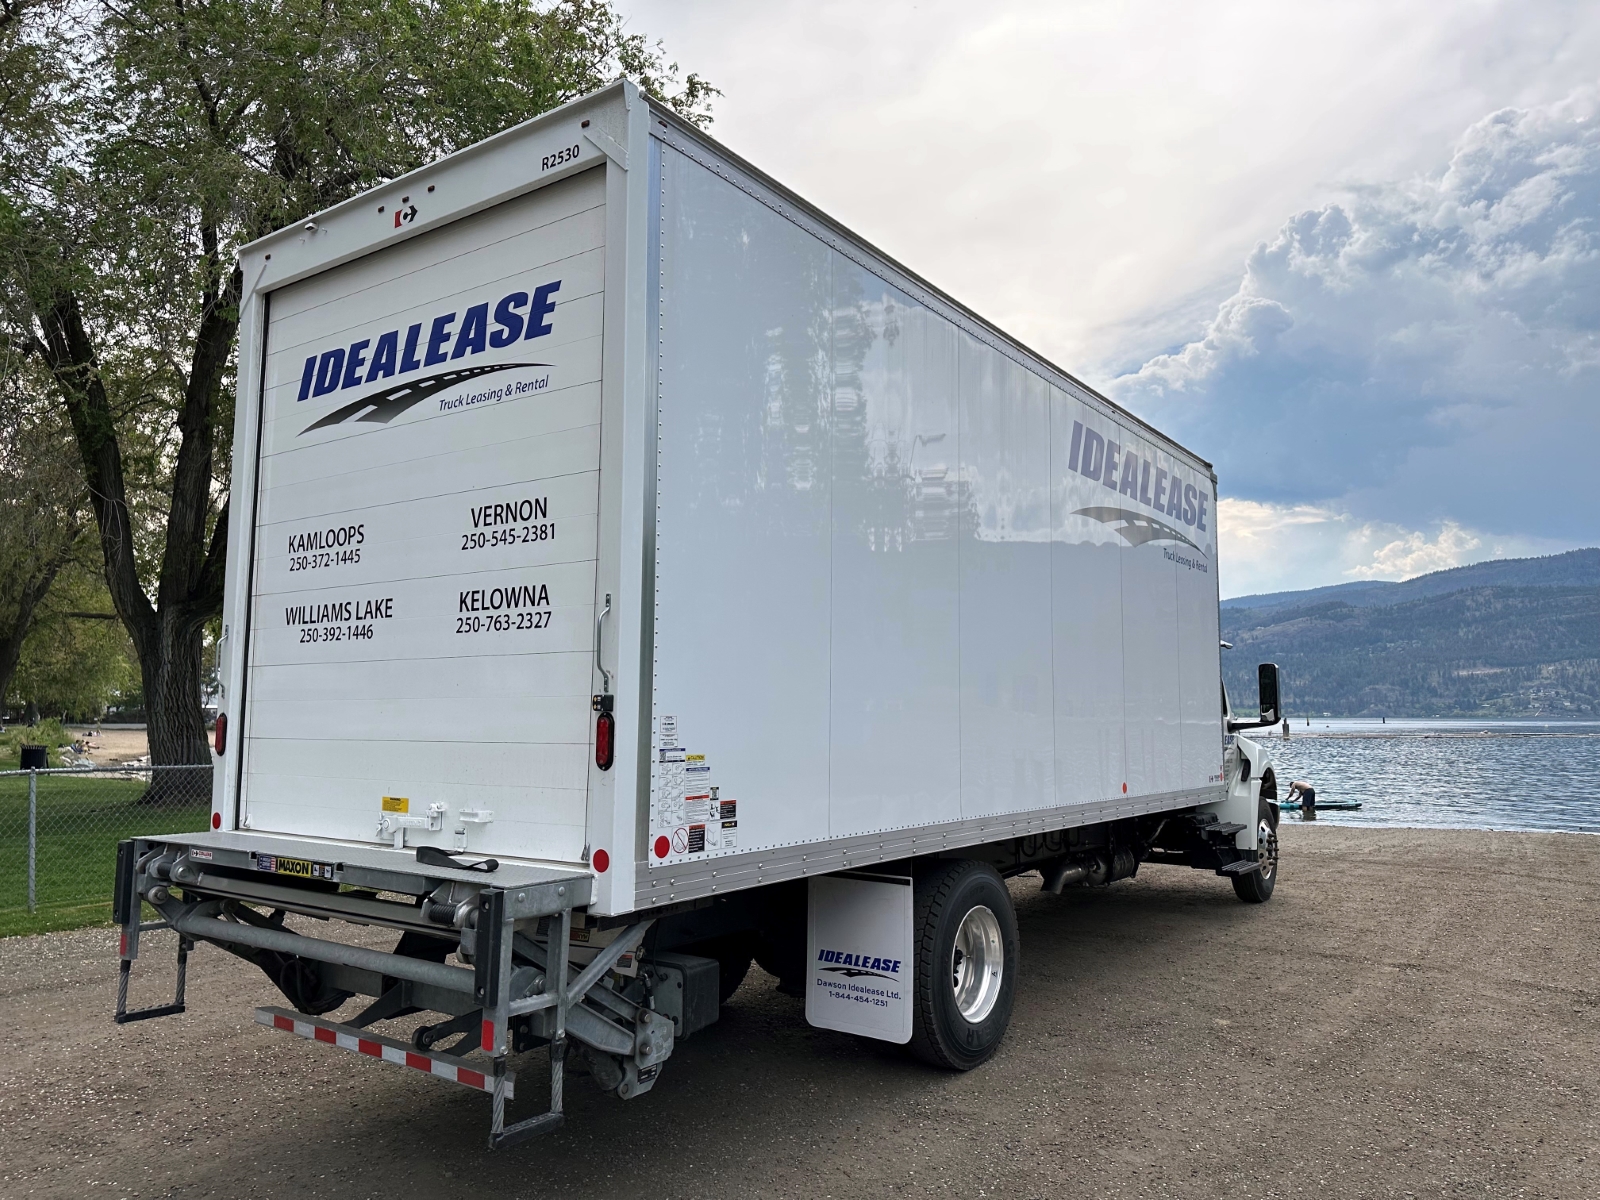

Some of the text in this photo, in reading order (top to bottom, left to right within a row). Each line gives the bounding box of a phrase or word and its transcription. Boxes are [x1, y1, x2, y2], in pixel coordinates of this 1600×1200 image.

[541, 144, 580, 171] R2530
[297, 280, 562, 402] IDEALEASE
[439, 374, 549, 411] Truck Leasing & Rental
[1068, 420, 1208, 532] IDEALEASE
[471, 497, 547, 528] VERNON
[288, 524, 365, 554] KAMLOOPS
[461, 523, 555, 550] 250-545-2381
[289, 548, 361, 571] 250-372-1445
[1163, 547, 1175, 561] Truck
[1176, 552, 1191, 570] Leasing
[1196, 559, 1207, 573] Rental
[285, 598, 393, 625] WILLIAMS LAKE
[459, 584, 550, 612] KELOWNA
[299, 624, 374, 643] 250-392-1446
[455, 611, 552, 633] 250-763-2327
[279, 859, 309, 874] MAXON
[818, 949, 901, 973] IDEALEASE
[817, 978, 901, 999] Dawson Idealease Ltd.
[829, 991, 888, 1007] 1-844-454-1251
